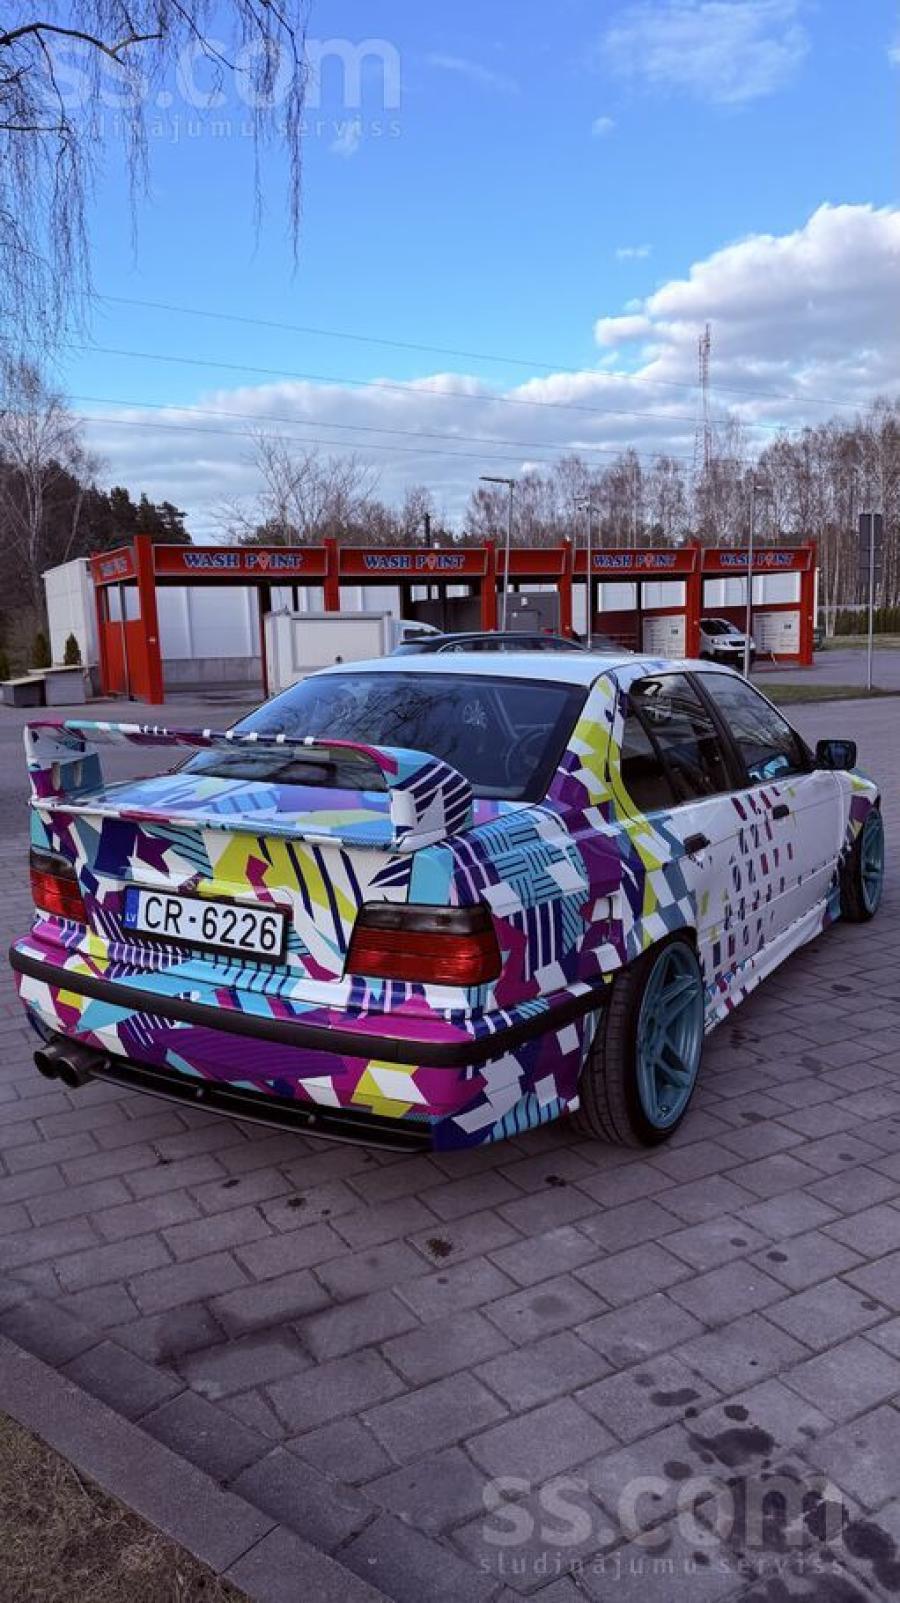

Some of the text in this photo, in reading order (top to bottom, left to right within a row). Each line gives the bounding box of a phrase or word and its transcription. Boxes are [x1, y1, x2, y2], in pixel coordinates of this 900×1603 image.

[183, 552, 240, 568] WASH
[363, 554, 411, 569] WASH
[593, 554, 632, 568] WASH
[126, 913, 137, 922] LV
[145, 896, 277, 951] CR-6226
